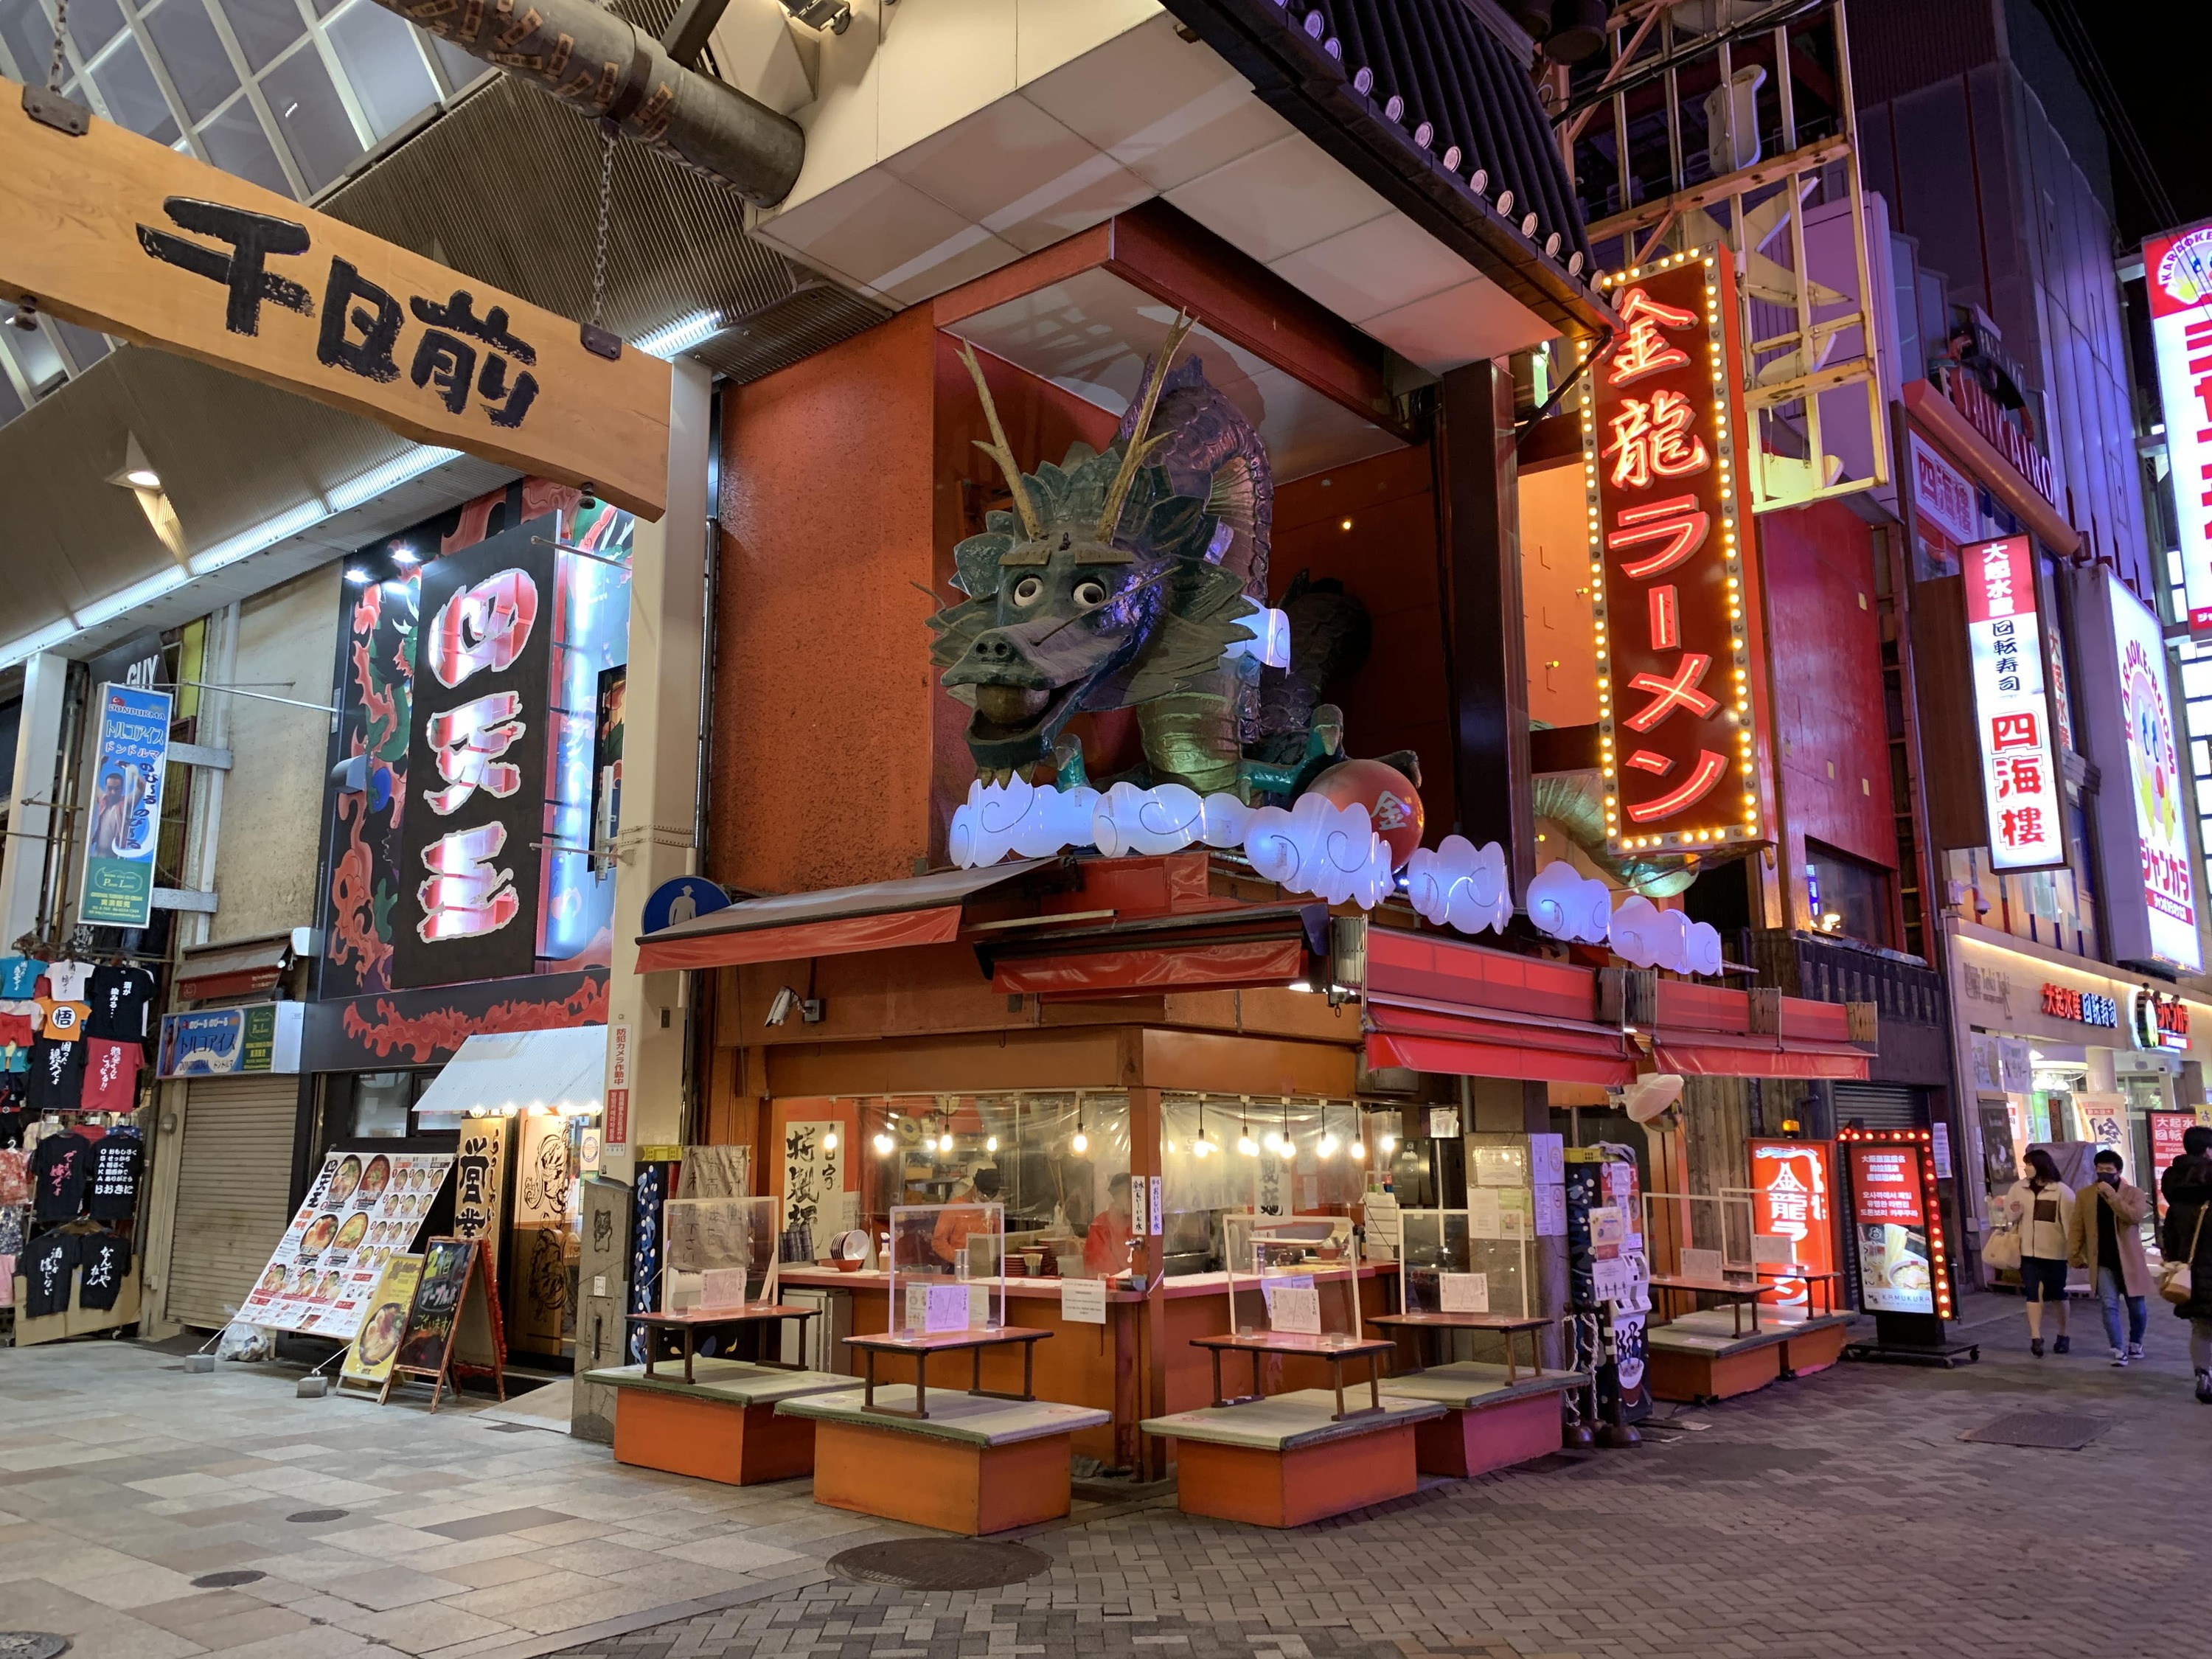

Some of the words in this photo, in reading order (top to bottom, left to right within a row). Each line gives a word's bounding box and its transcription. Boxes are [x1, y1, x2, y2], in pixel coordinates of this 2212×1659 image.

[136, 195, 540, 429] 千日前
[1601, 288, 1730, 824] 金龍ラーメン
[1982, 543, 2015, 617] 大起水産
[126, 655, 159, 691] GUY
[1992, 620, 2020, 692] 回転寿司
[105, 720, 164, 745] トルコアイス
[108, 704, 166, 720] DONDURMA
[105, 741, 160, 759] ドンドルマ
[416, 567, 539, 946] 四天王
[1989, 709, 2047, 849] 四海樓
[1370, 790, 1410, 831] 金
[55, 1009, 72, 1026] 悟
[180, 1033, 236, 1054] トルコアイス
[613, 1028, 627, 1086] 防犯カメラ作動中
[307, 1159, 338, 1208] 四天王
[86, 1265, 100, 1286] ねん
[98, 1246, 114, 1288] なんでや
[1882, 1294, 1930, 1303] KAMUKURA
